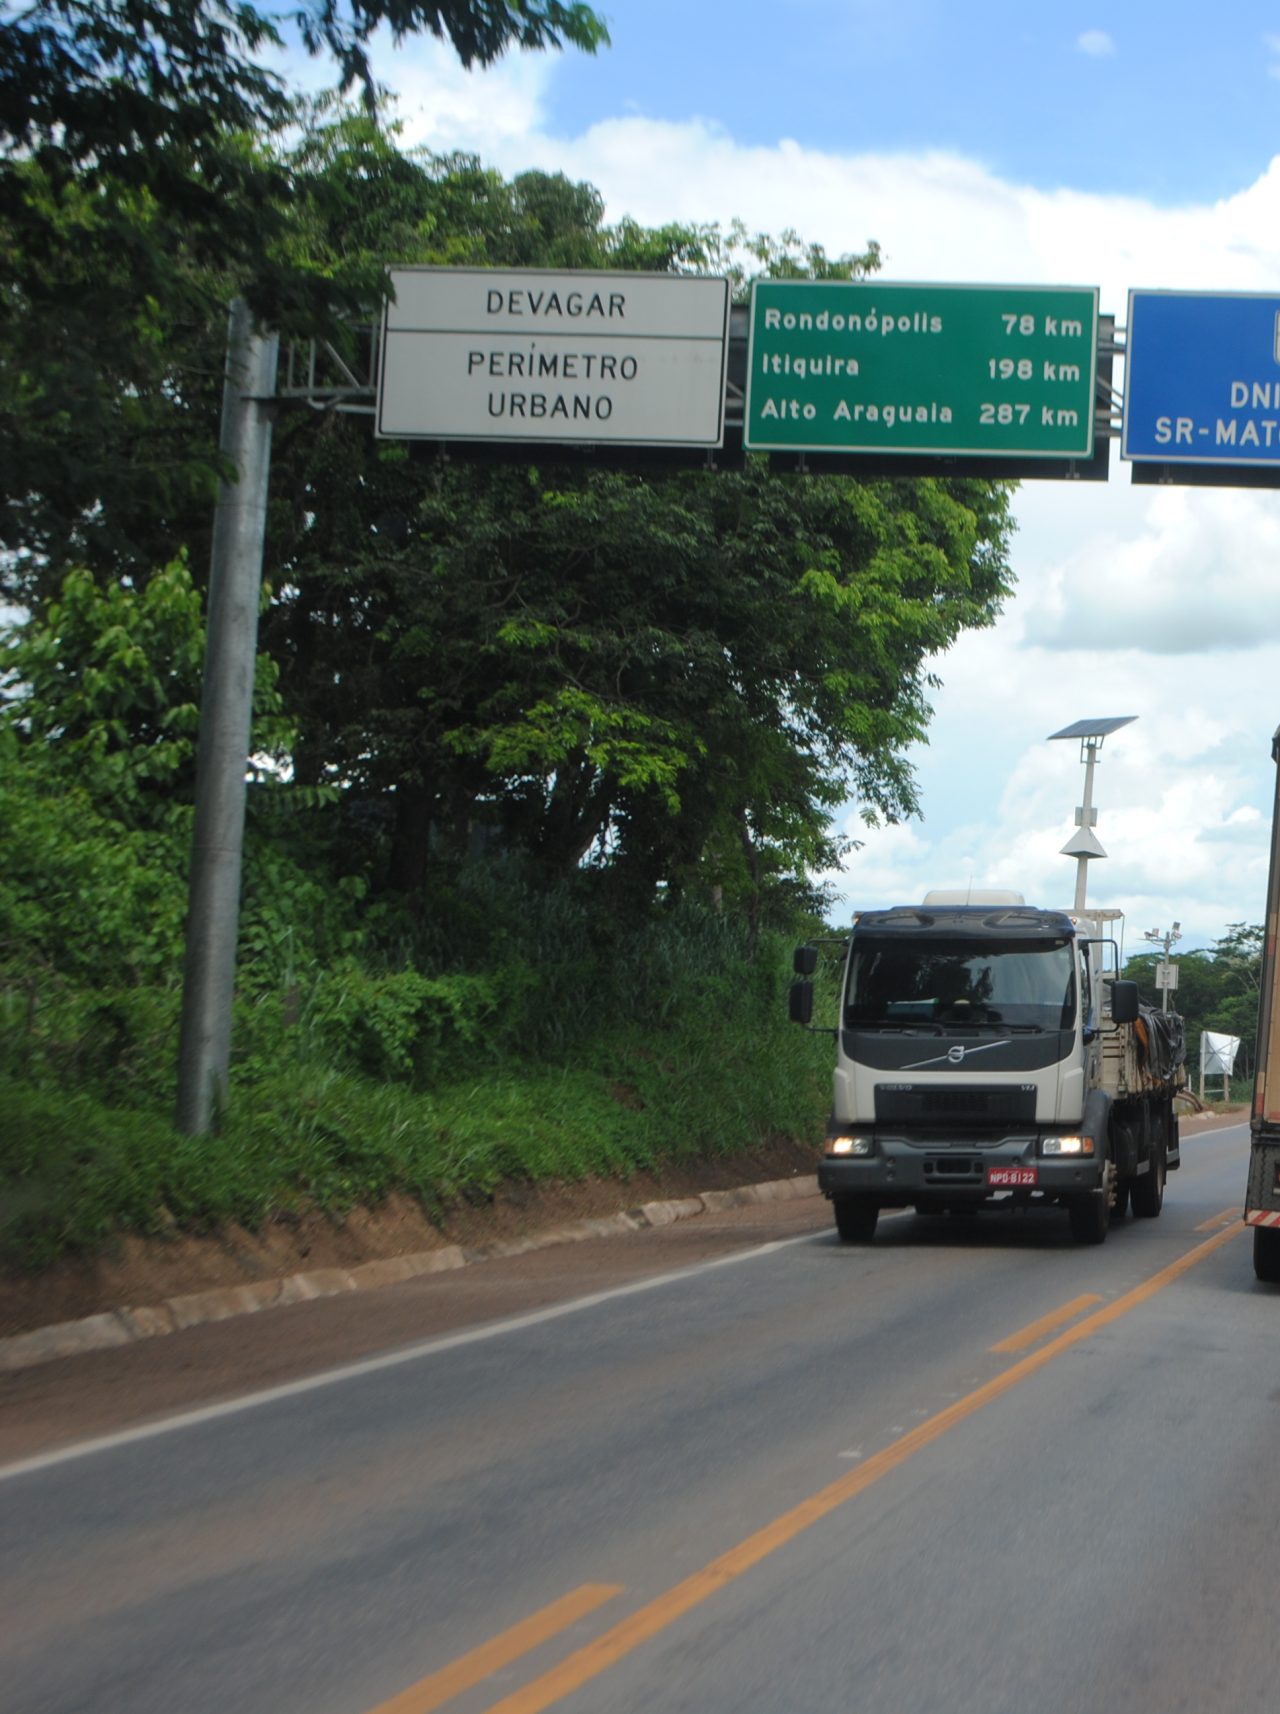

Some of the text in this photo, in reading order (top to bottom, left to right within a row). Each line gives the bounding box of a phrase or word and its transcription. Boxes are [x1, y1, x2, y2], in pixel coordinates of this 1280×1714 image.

[486, 289, 626, 318] DEVAGAR
[764, 307, 943, 337] Rondonópolis
[1002, 314, 1083, 337] 78 km
[467, 343, 638, 380] PERÍMETRO
[762, 353, 859, 379] Itiquira
[988, 358, 1081, 382] 198 km
[488, 392, 613, 420] URBANO
[760, 398, 953, 428] Alto Araguaia
[979, 403, 1079, 427] 287 km
